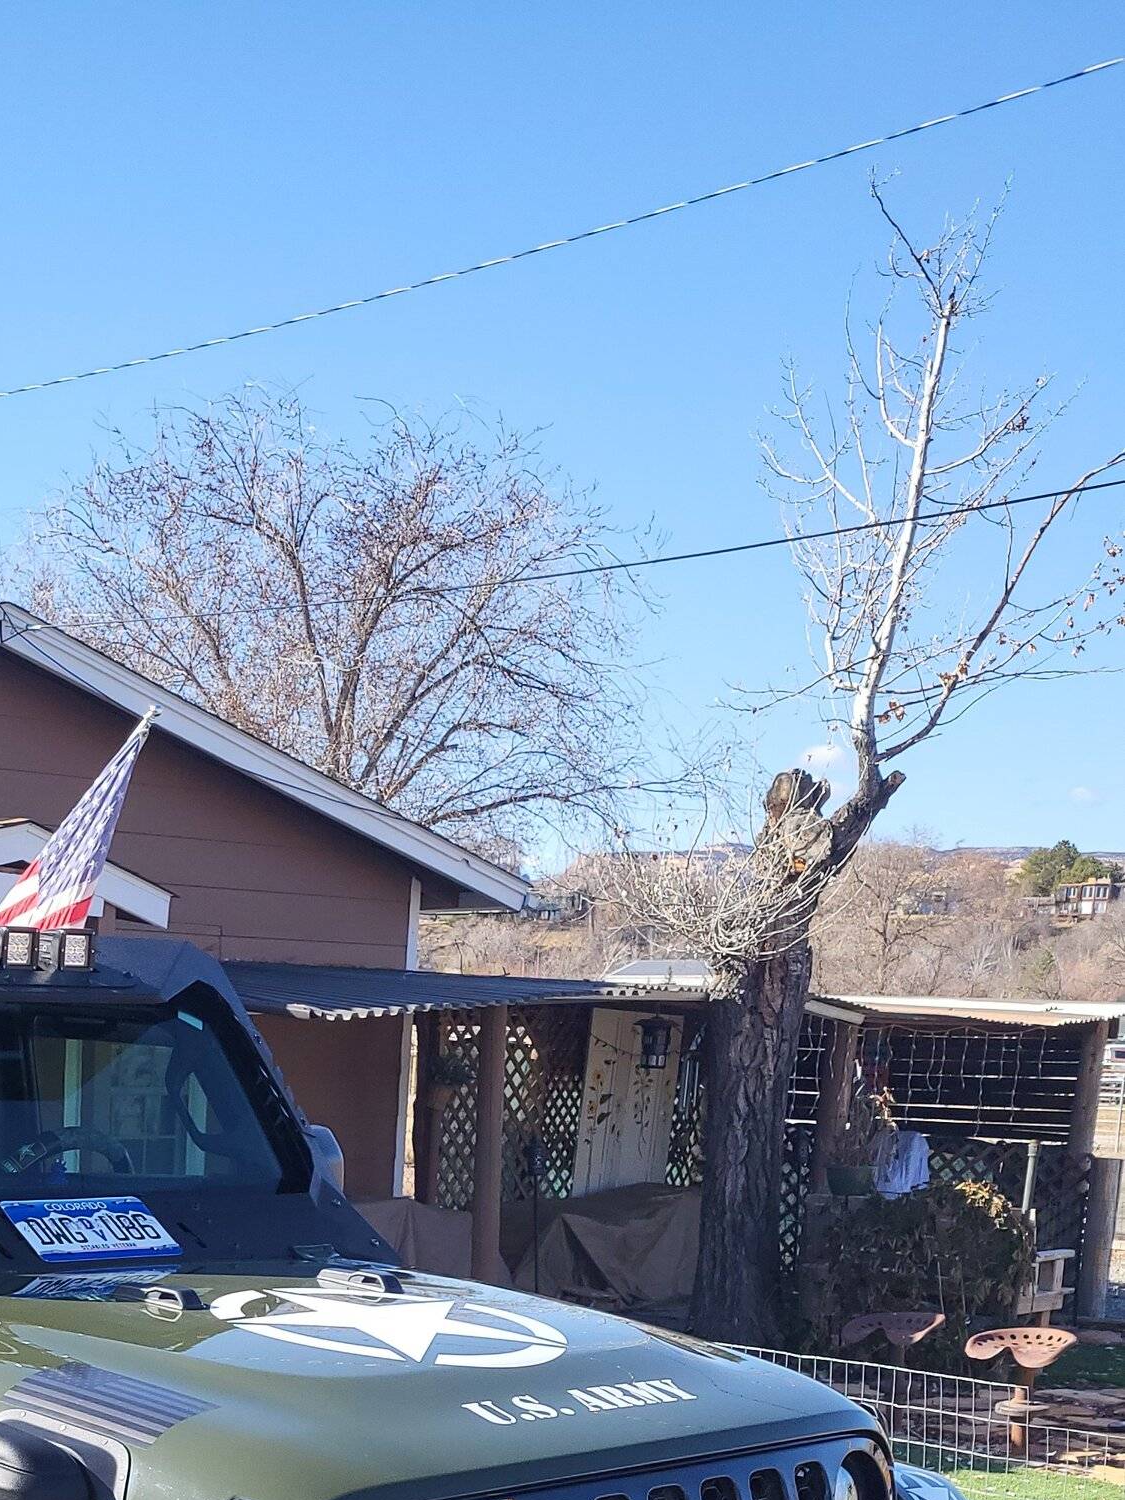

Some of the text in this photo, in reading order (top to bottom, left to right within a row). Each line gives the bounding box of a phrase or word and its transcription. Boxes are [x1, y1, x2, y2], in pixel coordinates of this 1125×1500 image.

[43, 1201, 108, 1212] COLORADO
[26, 1217, 89, 1246] DWG
[461, 1378, 698, 1426] U.S. ARMY
